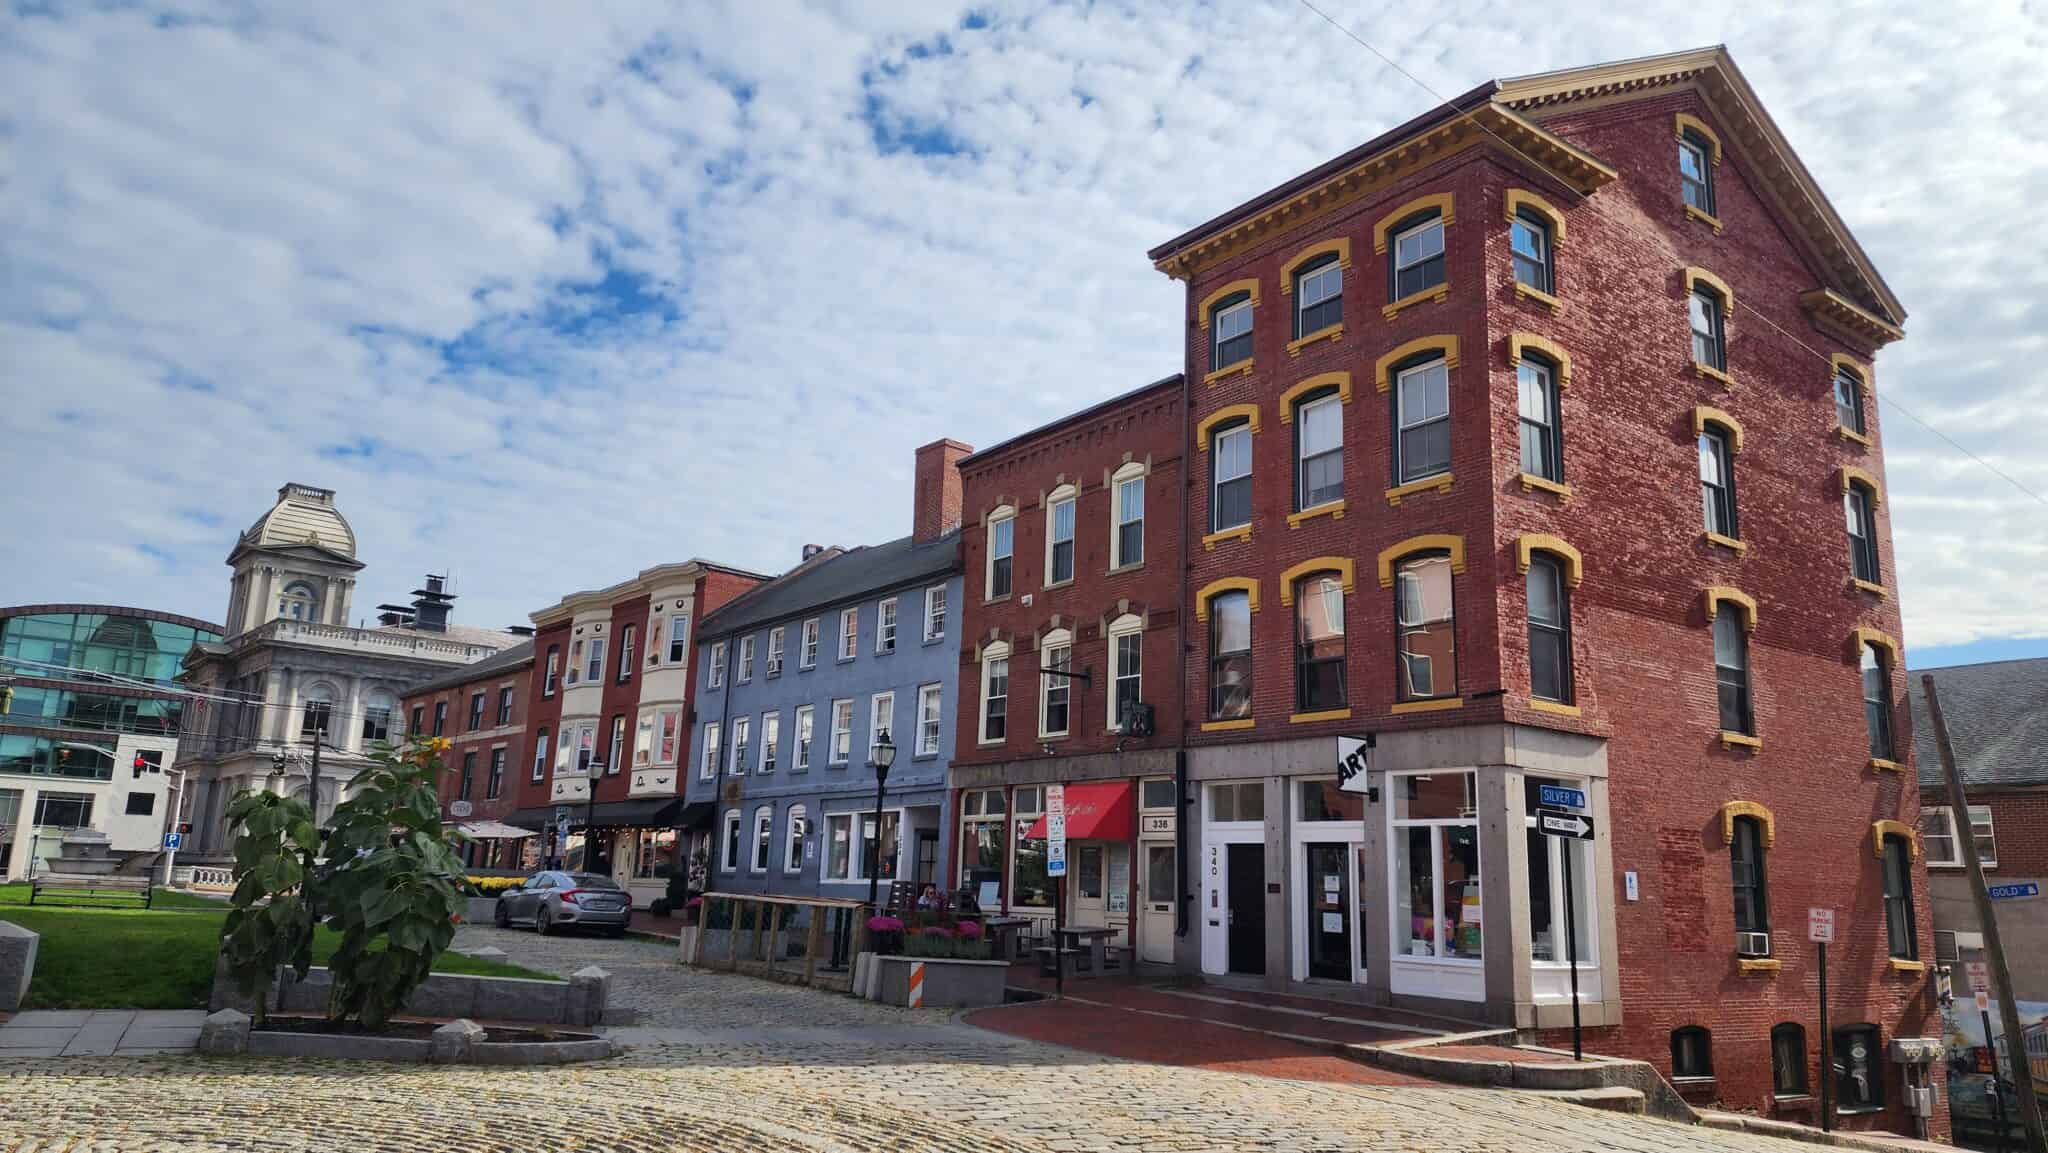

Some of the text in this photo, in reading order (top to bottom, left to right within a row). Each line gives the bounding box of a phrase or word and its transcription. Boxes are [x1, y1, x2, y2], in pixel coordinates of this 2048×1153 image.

[1339, 743, 1367, 785] ART
[1544, 789, 1570, 805] SILVER
[1545, 818, 1577, 831] ONE WAY
[1992, 887, 2018, 897] GOLD
